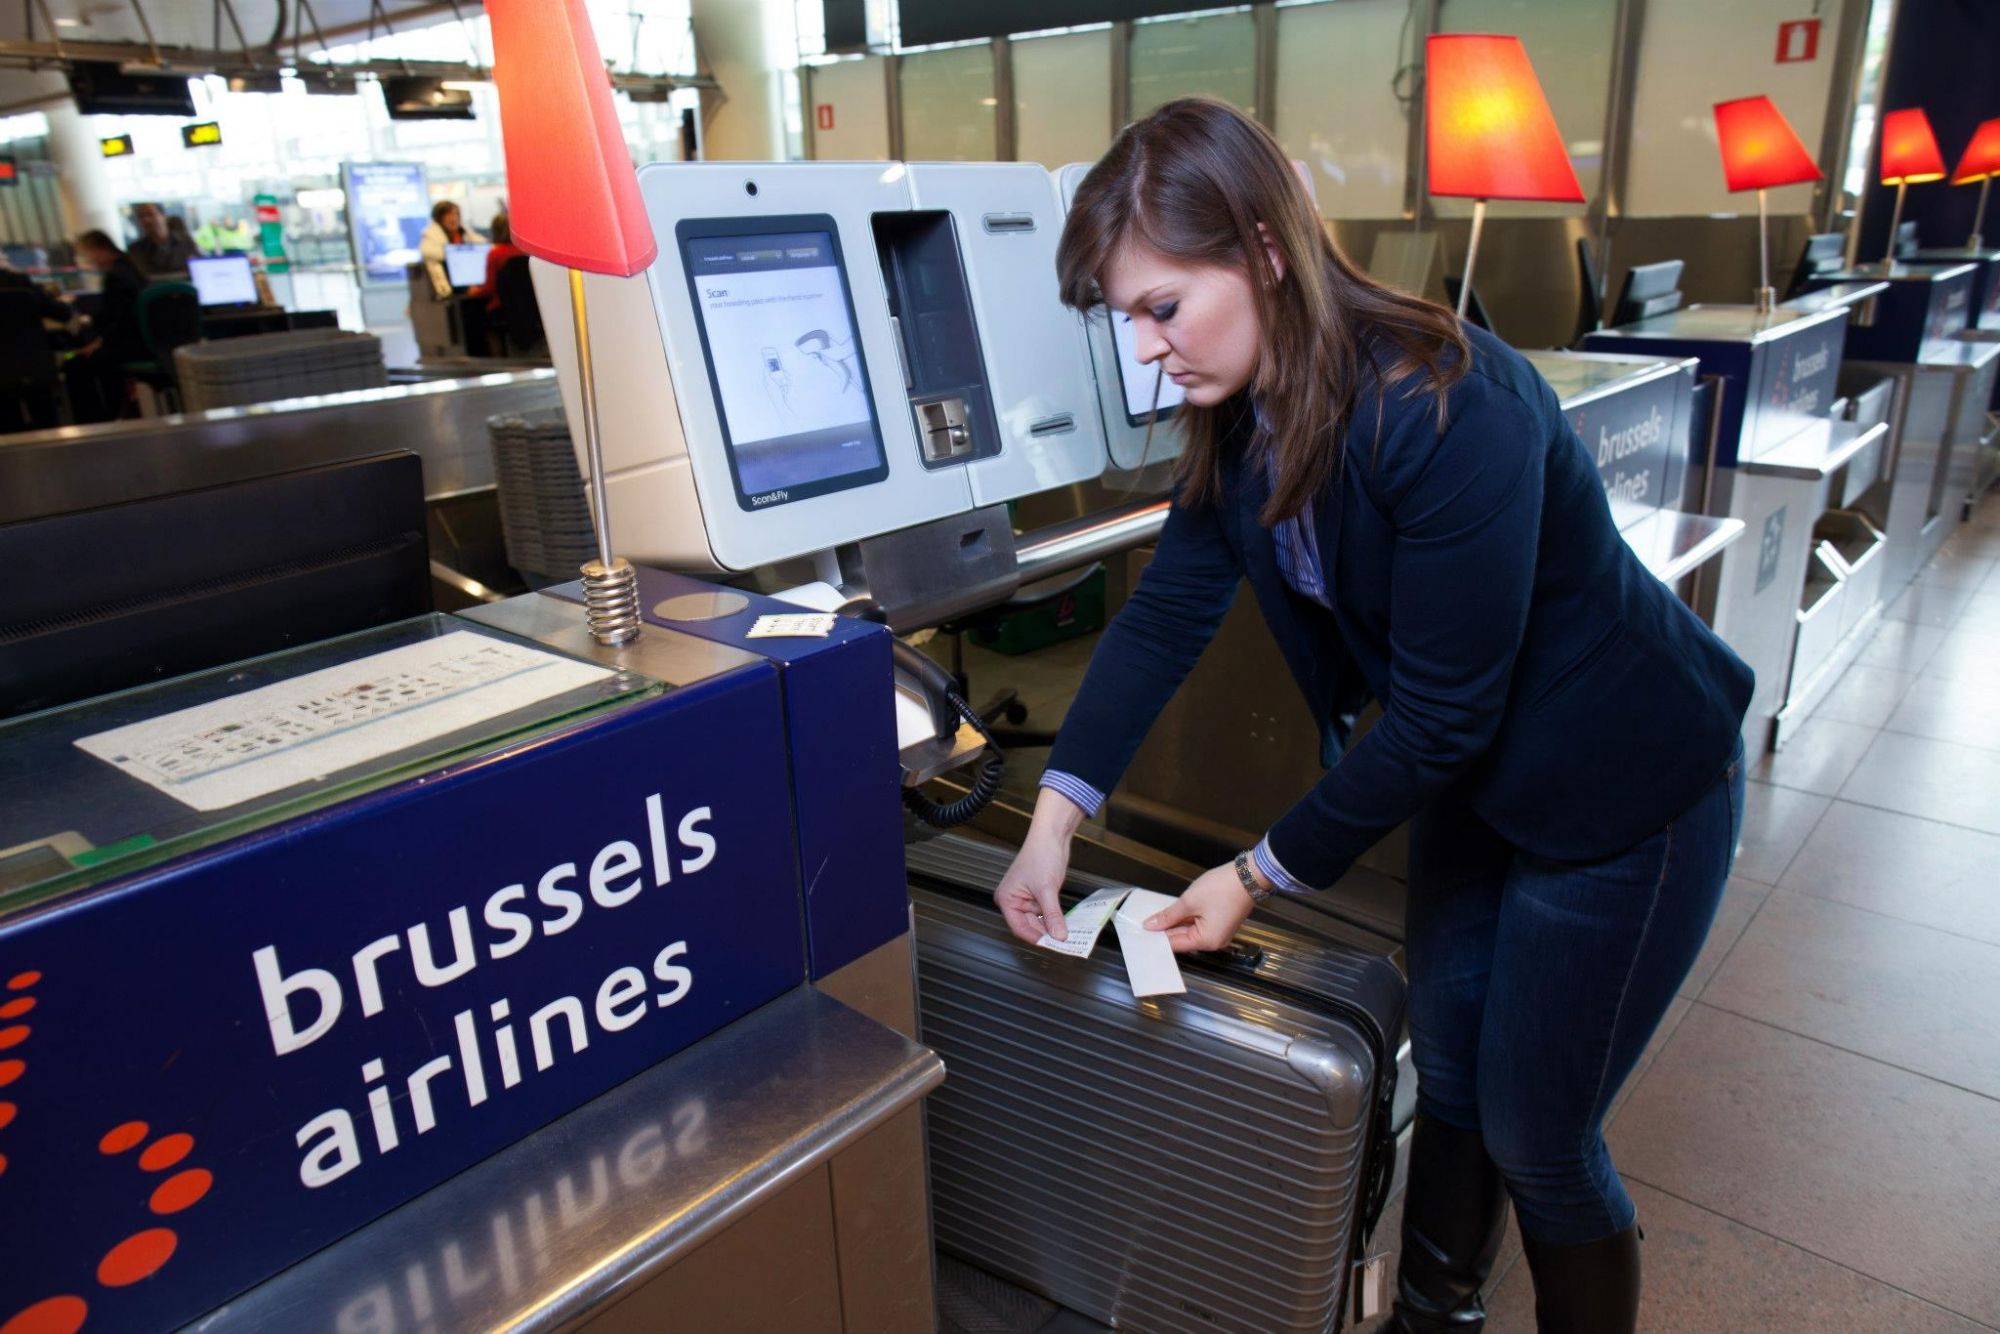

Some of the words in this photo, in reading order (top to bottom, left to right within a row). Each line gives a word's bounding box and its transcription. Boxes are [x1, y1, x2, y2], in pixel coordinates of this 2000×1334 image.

[705, 288, 728, 298] Scan
[1597, 405, 1662, 468] brussels
[751, 490, 788, 506] Scan&Fly
[252, 792, 717, 1057] brussels
[295, 940, 693, 1189] airlines
